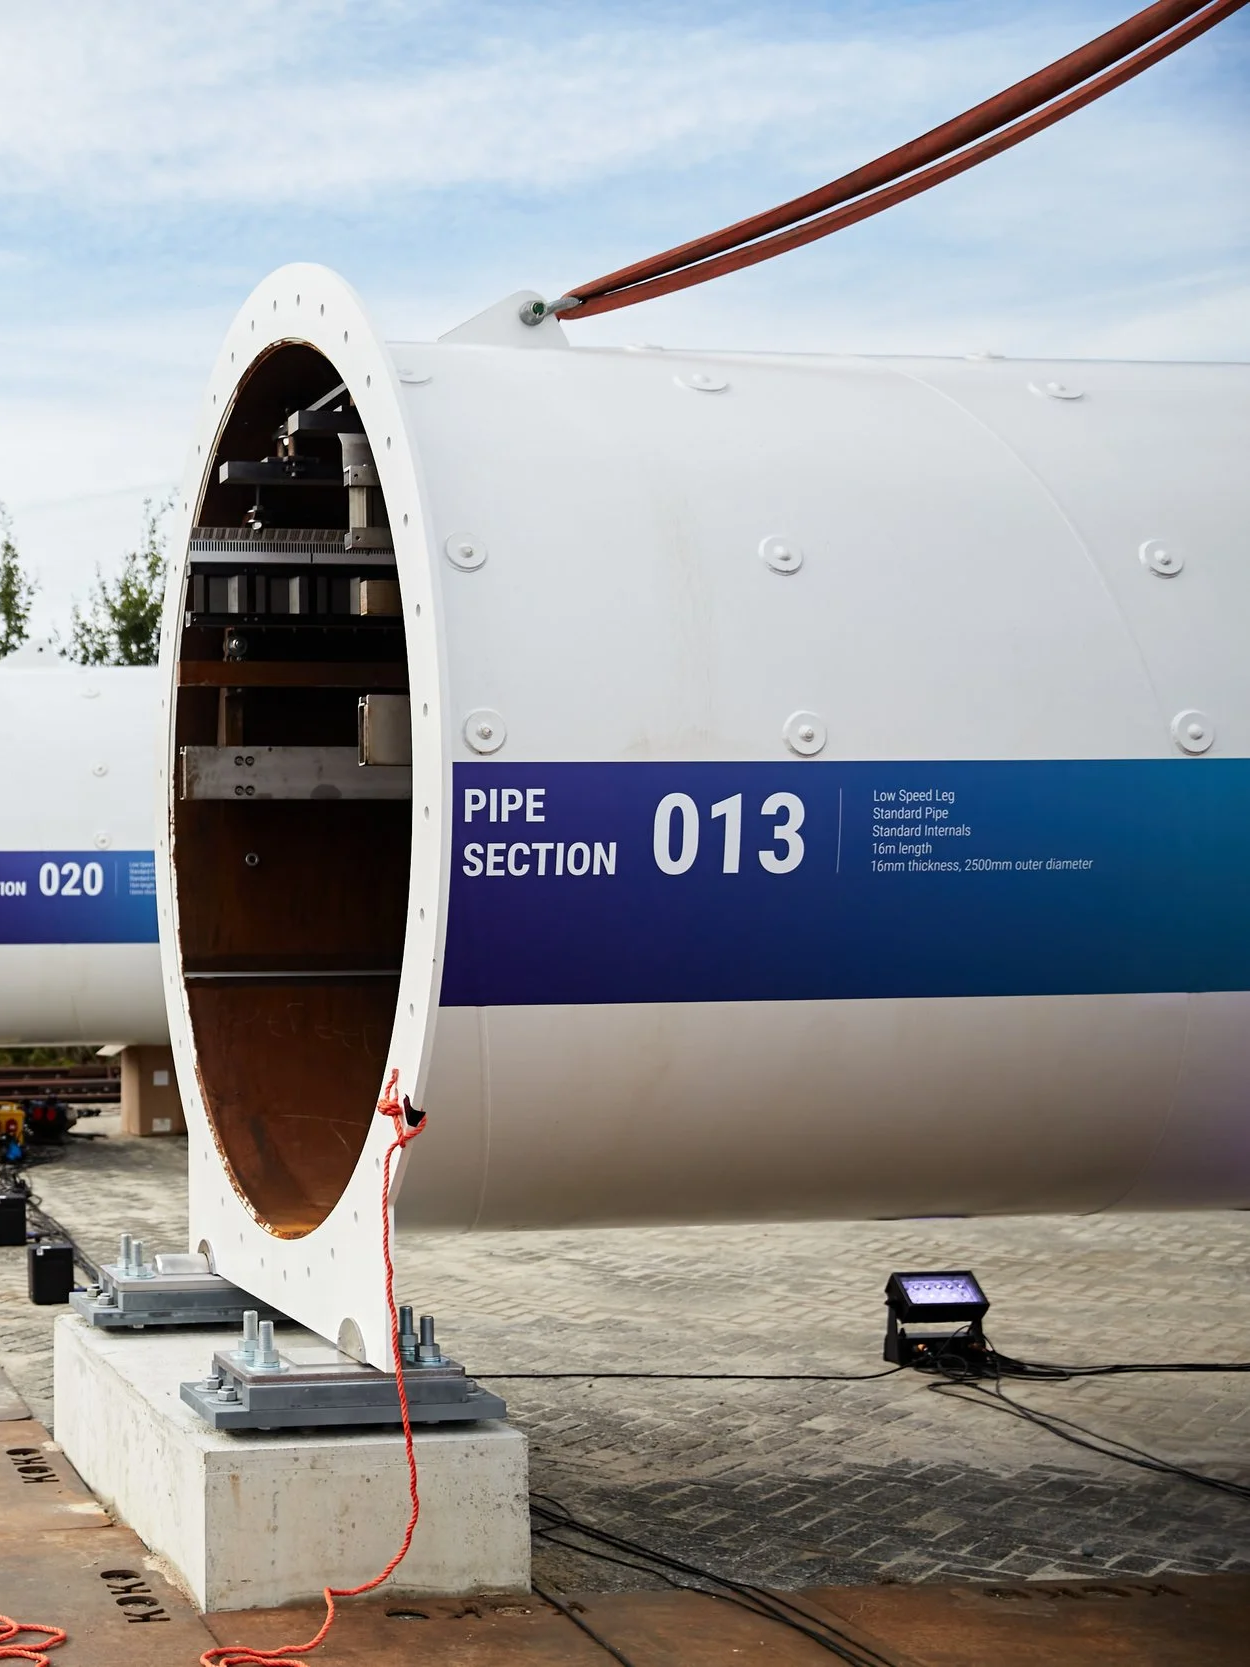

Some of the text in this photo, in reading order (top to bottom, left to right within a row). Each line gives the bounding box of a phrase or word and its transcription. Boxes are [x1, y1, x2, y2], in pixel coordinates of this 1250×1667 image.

[873, 788, 955, 804] Low Speed Leg
[463, 788, 546, 823] PIPE
[872, 806, 949, 822] Standard Pipe
[653, 791, 806, 876] 013
[872, 823, 972, 837] Standard Internals
[871, 841, 933, 857] 16m length
[461, 841, 617, 877] SECTION
[870, 858, 1094, 873] 16mm thickness, 2500mm outer diameter
[38, 861, 104, 897] 020
